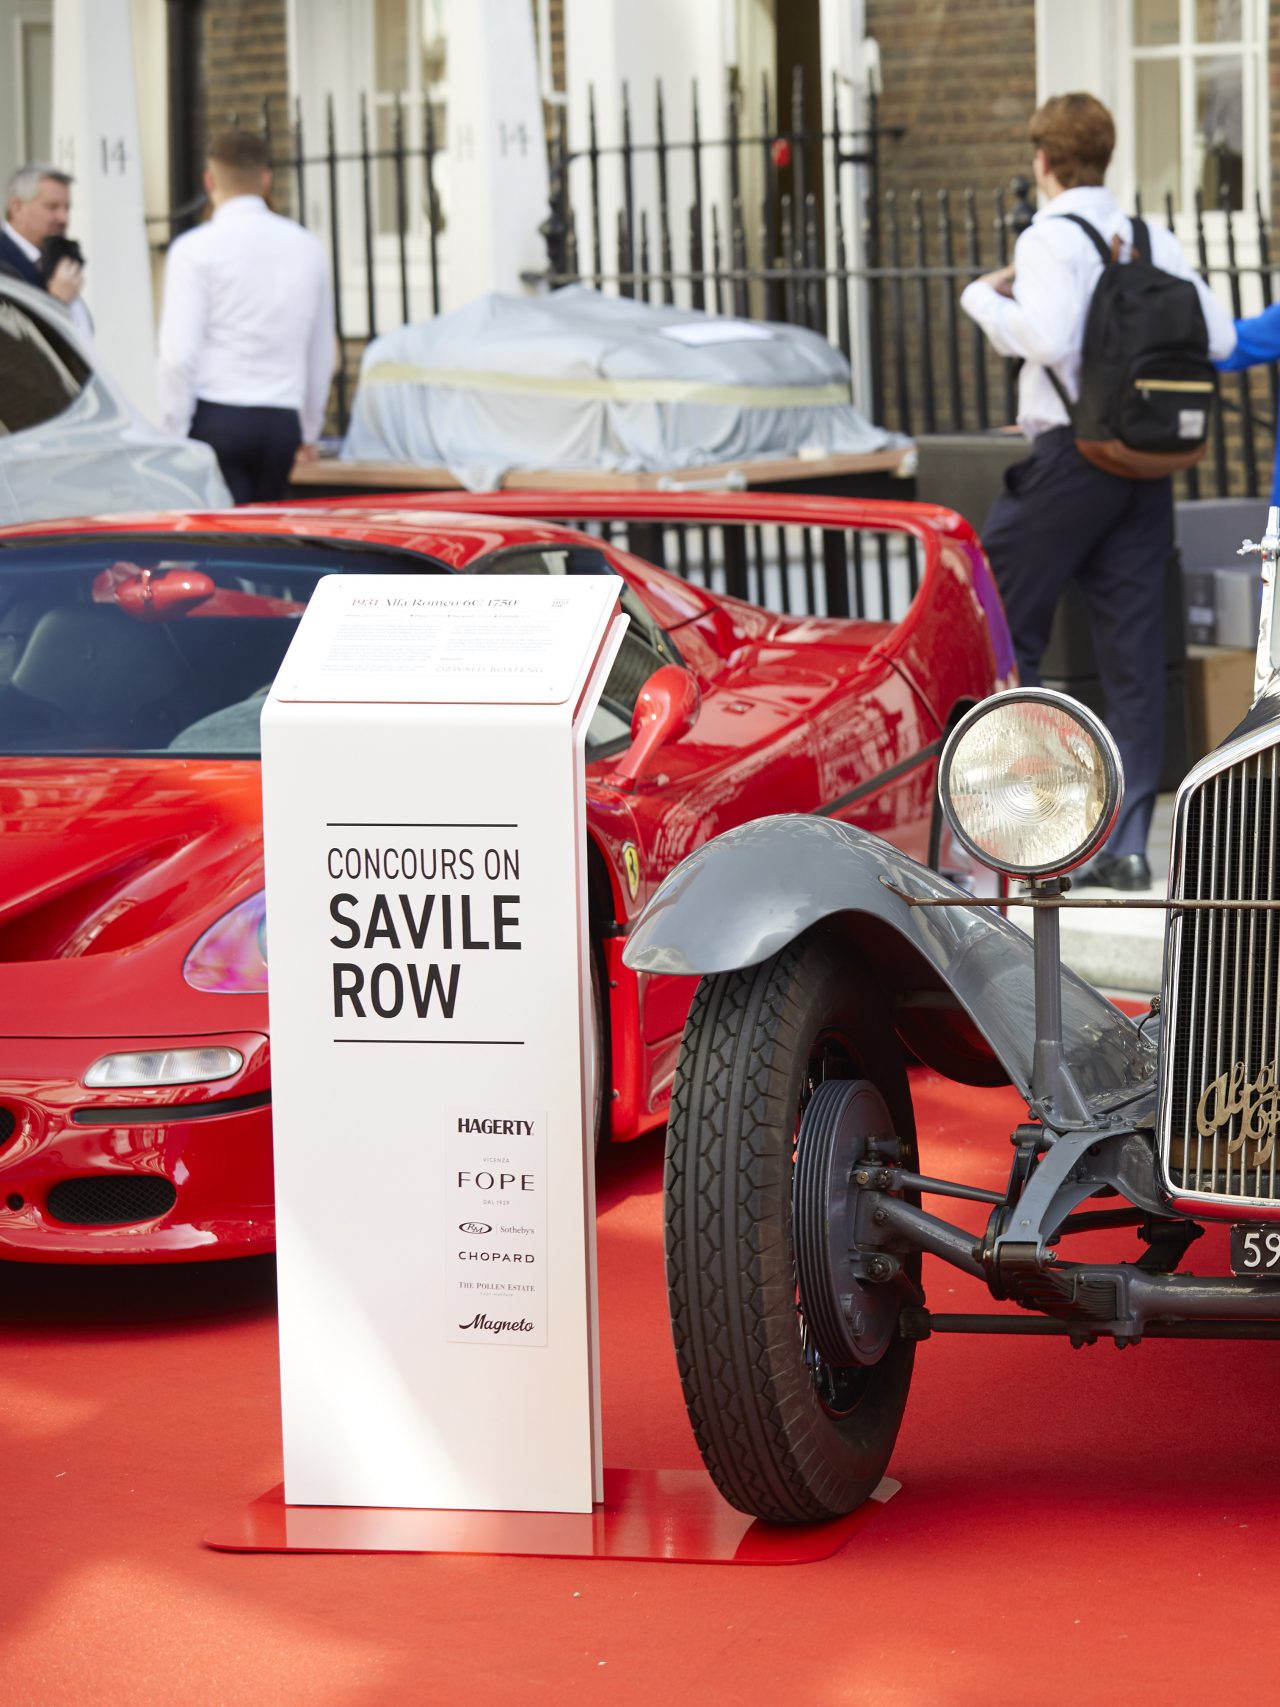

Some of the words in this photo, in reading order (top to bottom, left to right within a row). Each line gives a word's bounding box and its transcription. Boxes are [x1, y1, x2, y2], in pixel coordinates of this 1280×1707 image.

[101, 137, 129, 175] 14
[327, 847, 475, 880] CONCOURS
[484, 848, 520, 880] ON
[329, 893, 522, 950] SAVILE
[332, 962, 461, 1019] ROW
[457, 1117, 535, 1136] HAGERTY
[457, 1171, 535, 1191] FOPE
[500, 1226, 535, 1236] Sotheby's
[458, 1251, 535, 1263] CHOPARD
[458, 1281, 475, 1289] THE
[476, 1282, 506, 1291] POLLEN
[508, 1283, 536, 1292] ESTATE
[458, 1313, 535, 1334] Magneto
